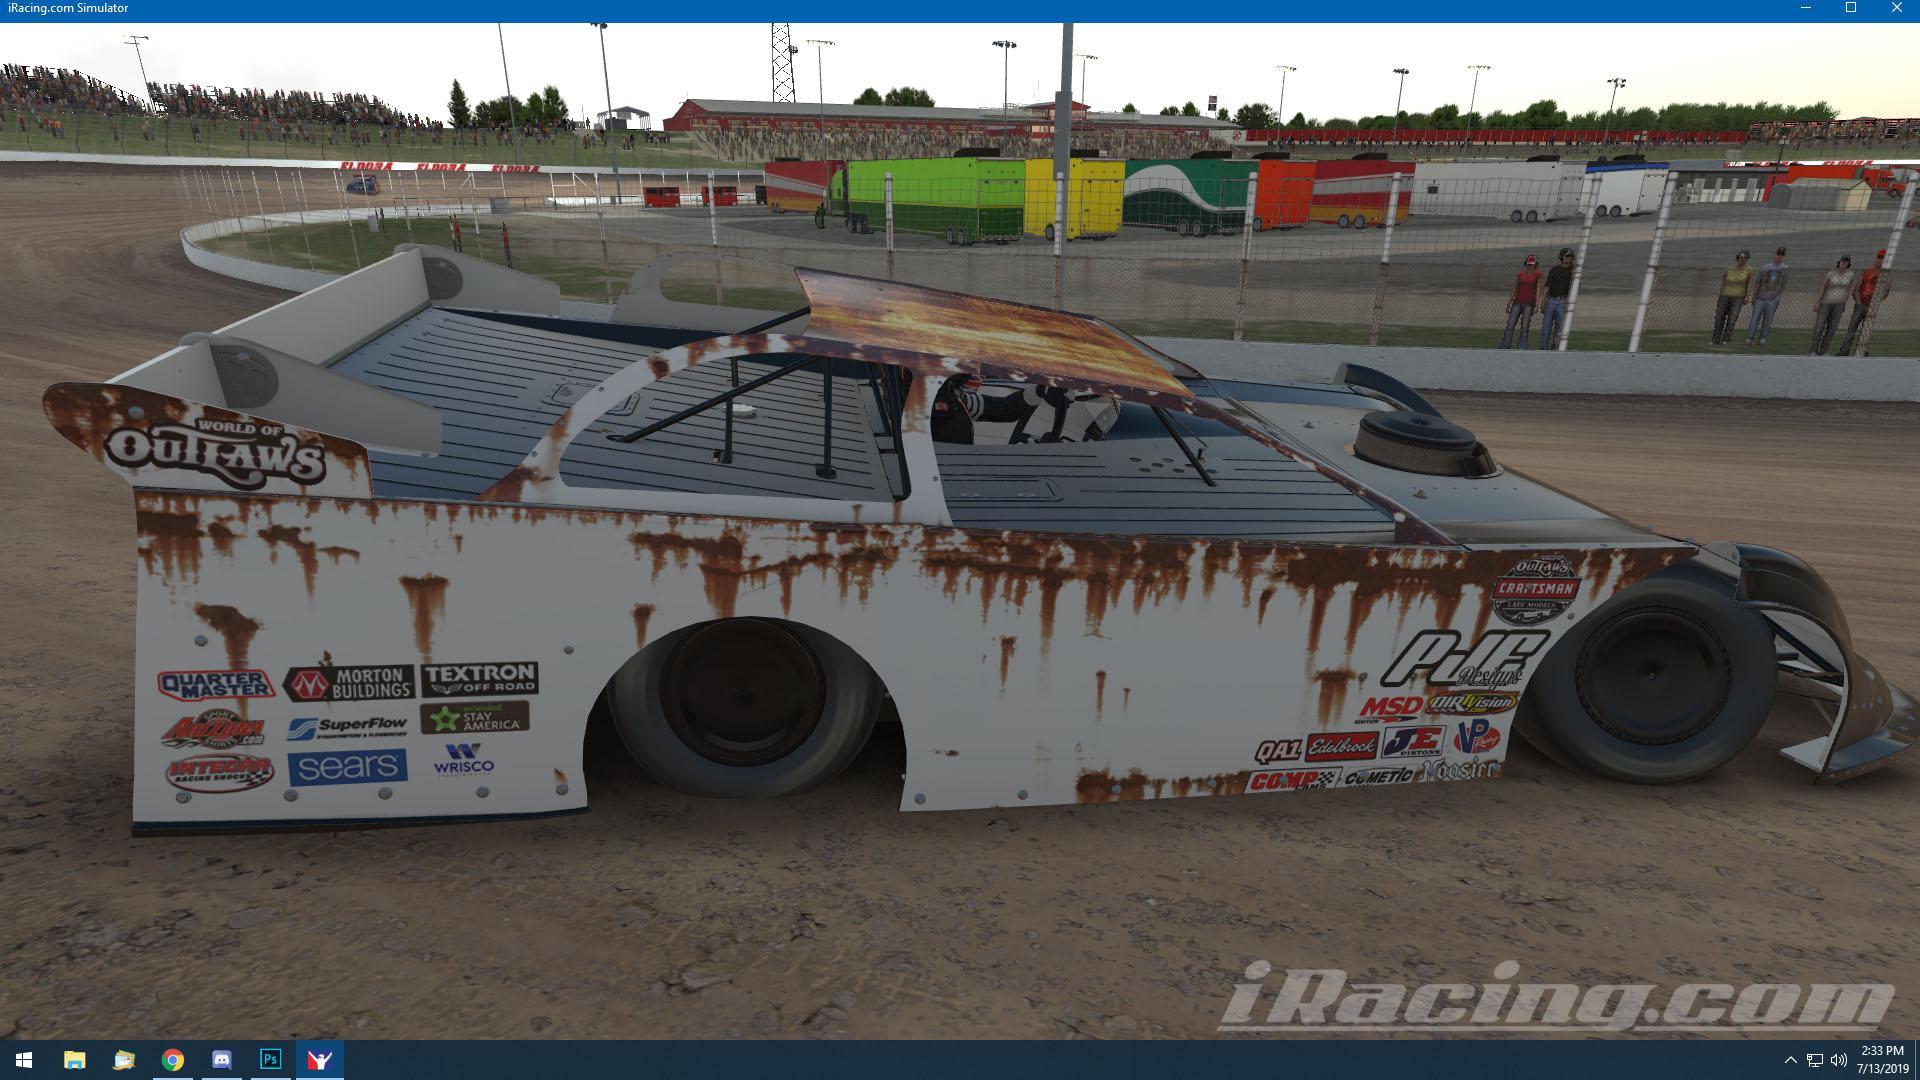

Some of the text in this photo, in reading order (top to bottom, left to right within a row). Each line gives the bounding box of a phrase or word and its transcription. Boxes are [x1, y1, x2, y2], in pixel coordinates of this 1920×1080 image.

[8, 3, 128, 15] iRacing.com Simulator
[198, 420, 282, 436] WORLD OF
[1499, 582, 1573, 594] CRAFTSMAN
[337, 669, 402, 683] MORTON
[425, 664, 534, 682] TEXTRON
[1457, 665, 1522, 690] Designs
[162, 672, 262, 692] QUARTER
[464, 682, 535, 692] OFF ROAD
[182, 684, 269, 698] MASTER
[332, 683, 410, 699] BUILDINGS
[1359, 697, 1424, 716] MSD
[319, 717, 408, 731] SuperFlow
[464, 712, 492, 722] STAY
[464, 720, 520, 731] AMERICA
[1384, 728, 1442, 755] JE
[1458, 719, 1489, 753] VP
[1256, 740, 1301, 764] QA1
[1308, 738, 1375, 755] Edelbrock
[299, 755, 398, 780] sears
[434, 761, 494, 773] WRISCO
[1250, 771, 1319, 790] COMP
[1345, 767, 1414, 785] COMETIC
[1862, 1046, 1904, 1056] 2:33 PM
[1857, 1063, 1909, 1074] 7/13/2019
